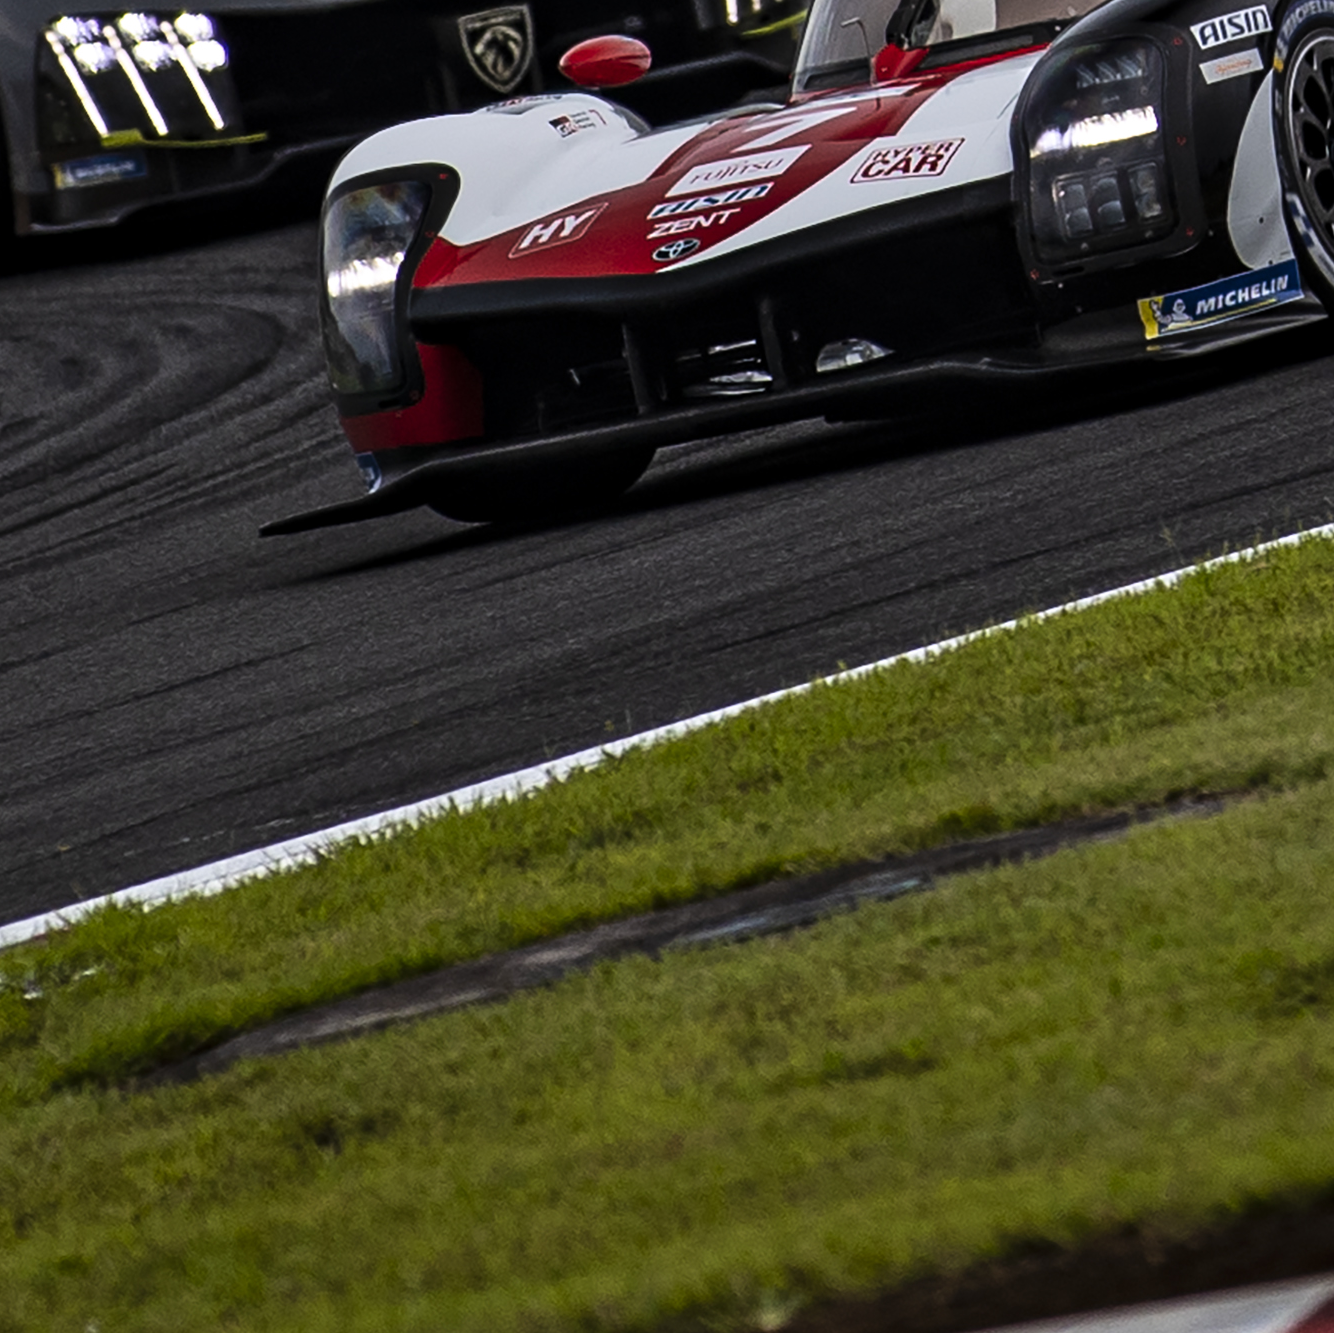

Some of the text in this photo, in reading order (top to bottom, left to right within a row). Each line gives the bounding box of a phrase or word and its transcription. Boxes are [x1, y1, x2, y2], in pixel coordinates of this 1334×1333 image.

[1199, 9, 1269, 46] AISIN
[861, 153, 945, 179] CAR
[517, 208, 597, 250] HY
[646, 207, 742, 240] ZENT
[1196, 274, 1289, 316] MICHELIN
